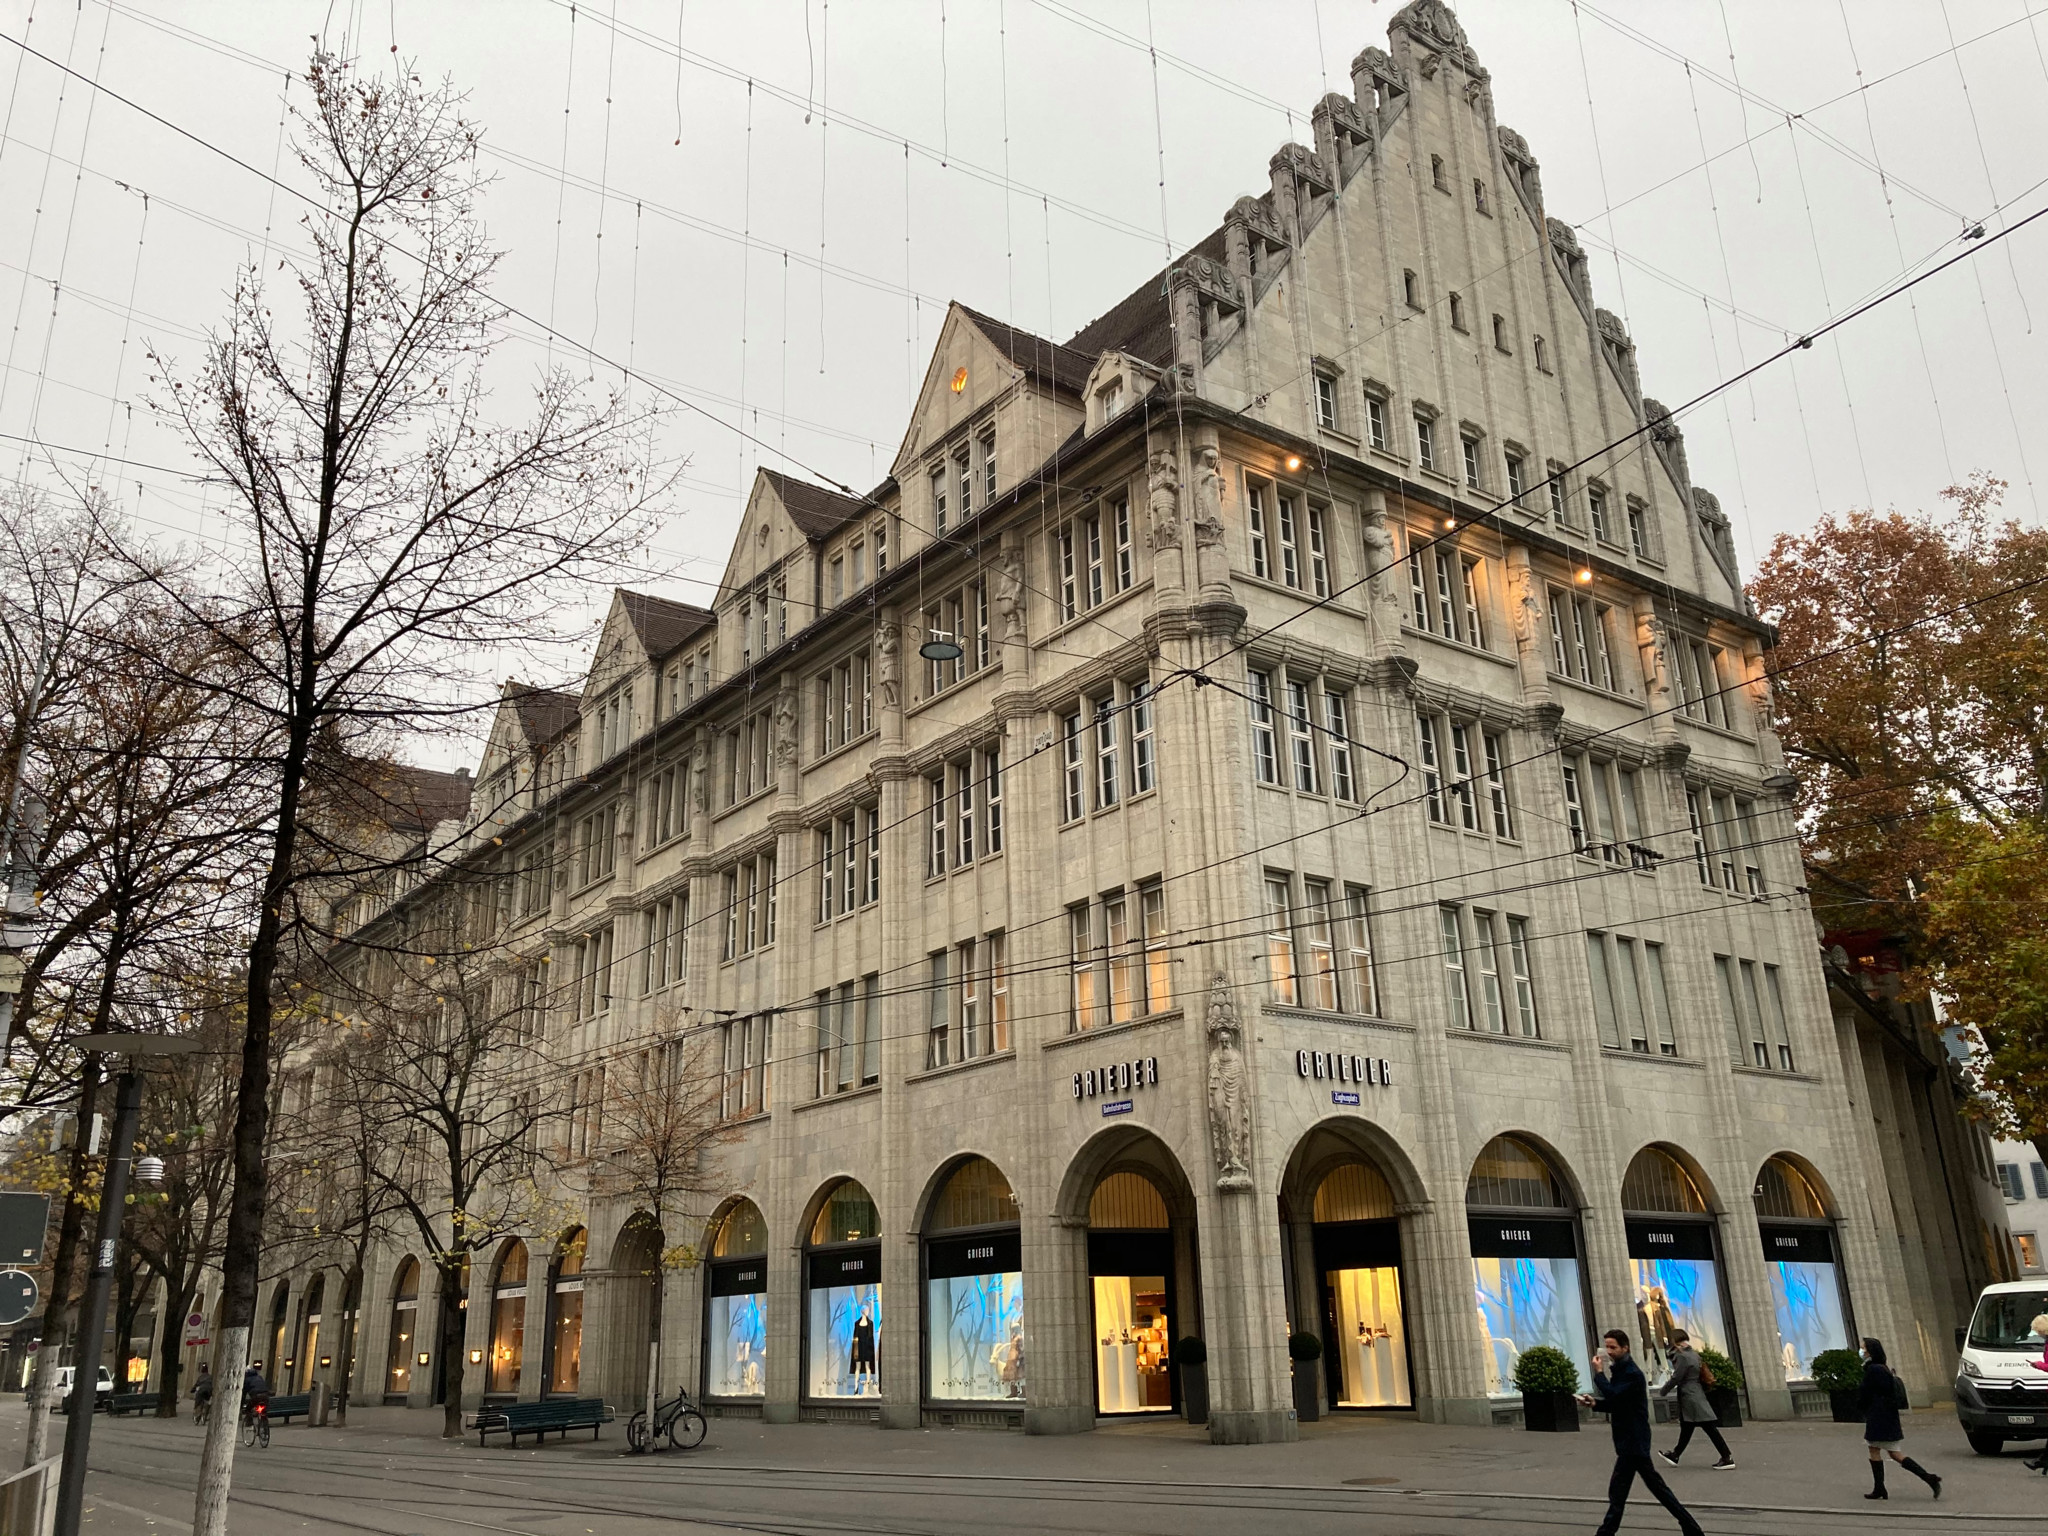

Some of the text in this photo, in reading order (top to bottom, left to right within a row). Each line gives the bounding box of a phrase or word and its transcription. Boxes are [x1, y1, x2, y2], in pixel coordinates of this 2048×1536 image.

[1297, 1050, 1391, 1085] GRIEDER
[1072, 1057, 1158, 1098] GRIEDER
[1501, 1230, 1531, 1240] GRIEDER
[1648, 1233, 1674, 1243] GRIEDER
[1775, 1237, 1798, 1247] GRIEDER
[967, 1247, 993, 1259] GRIEDER
[842, 1260, 863, 1271] GRIEDER
[738, 1271, 757, 1281] GRIEDER
